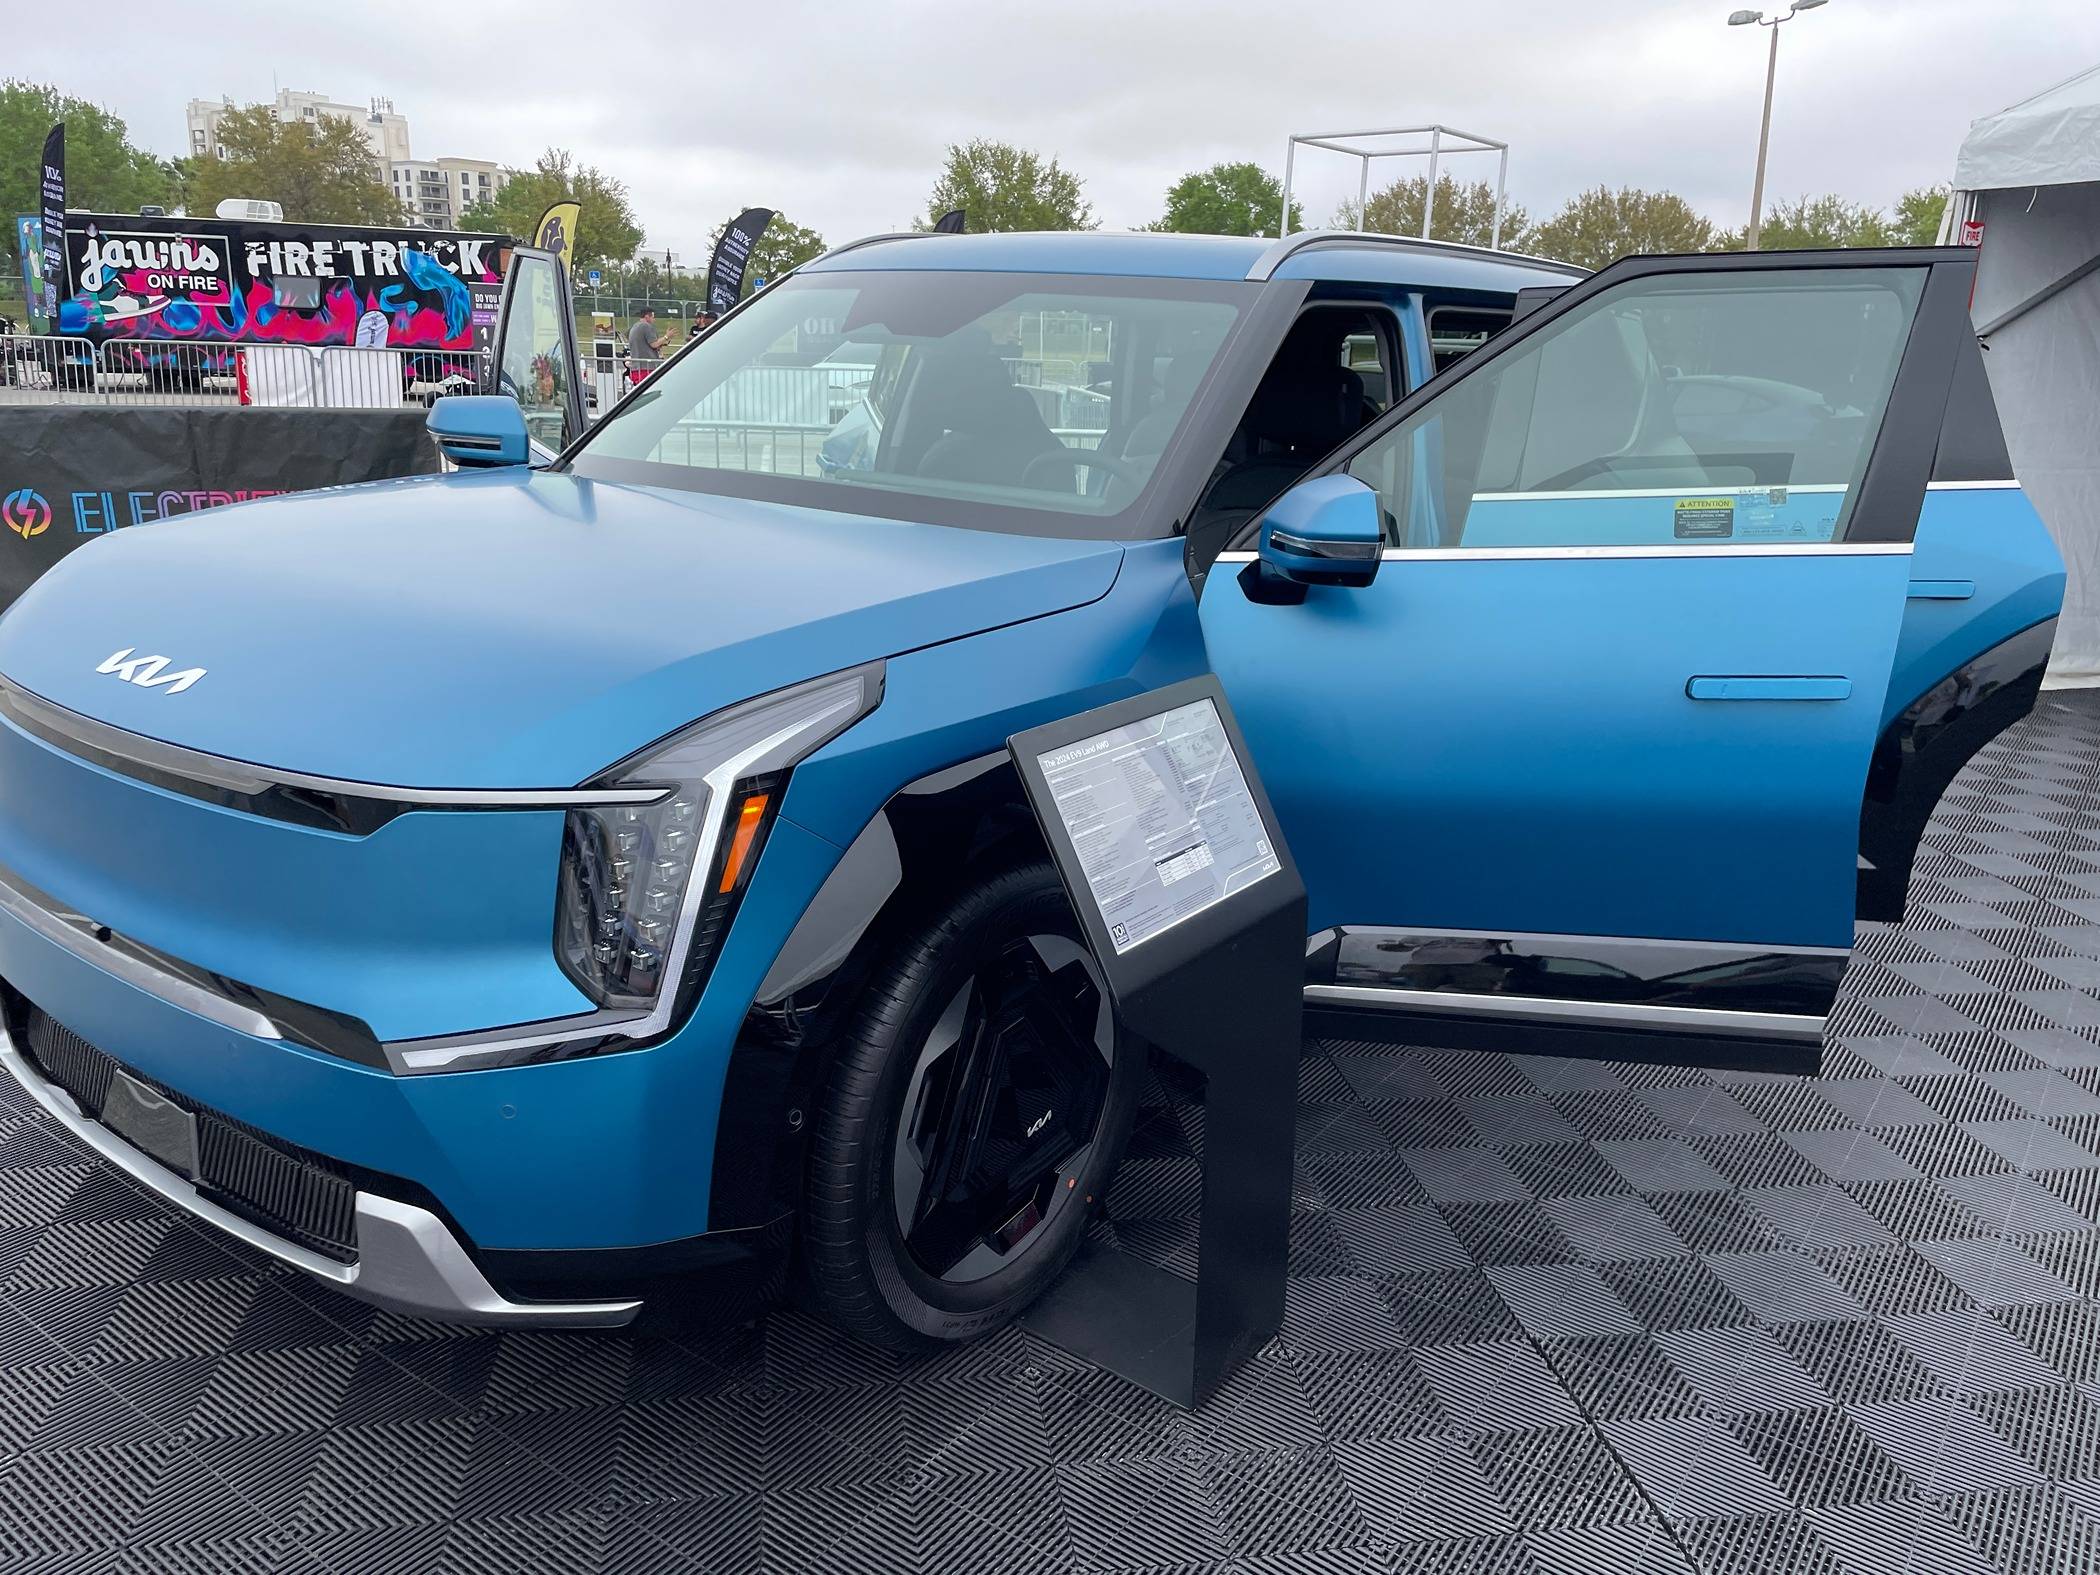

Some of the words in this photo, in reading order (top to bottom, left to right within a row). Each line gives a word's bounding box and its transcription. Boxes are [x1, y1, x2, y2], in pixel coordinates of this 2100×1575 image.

[732, 227, 752, 246] 100%
[1966, 231, 1980, 242] FIRE
[244, 240, 336, 278] FIRE
[342, 240, 496, 277] TRCK
[147, 274, 174, 289] ON
[179, 275, 219, 291] FIRE
[475, 293, 484, 303] DO
[485, 294, 498, 304] YOU
[1687, 500, 1730, 508] ATTENTION
[95, 647, 208, 696] KIA
[1043, 759, 1057, 769] The
[1055, 752, 1071, 765] 2024
[1070, 749, 1083, 760] EV9
[1082, 744, 1096, 756] Land
[1095, 740, 1110, 752] AWD
